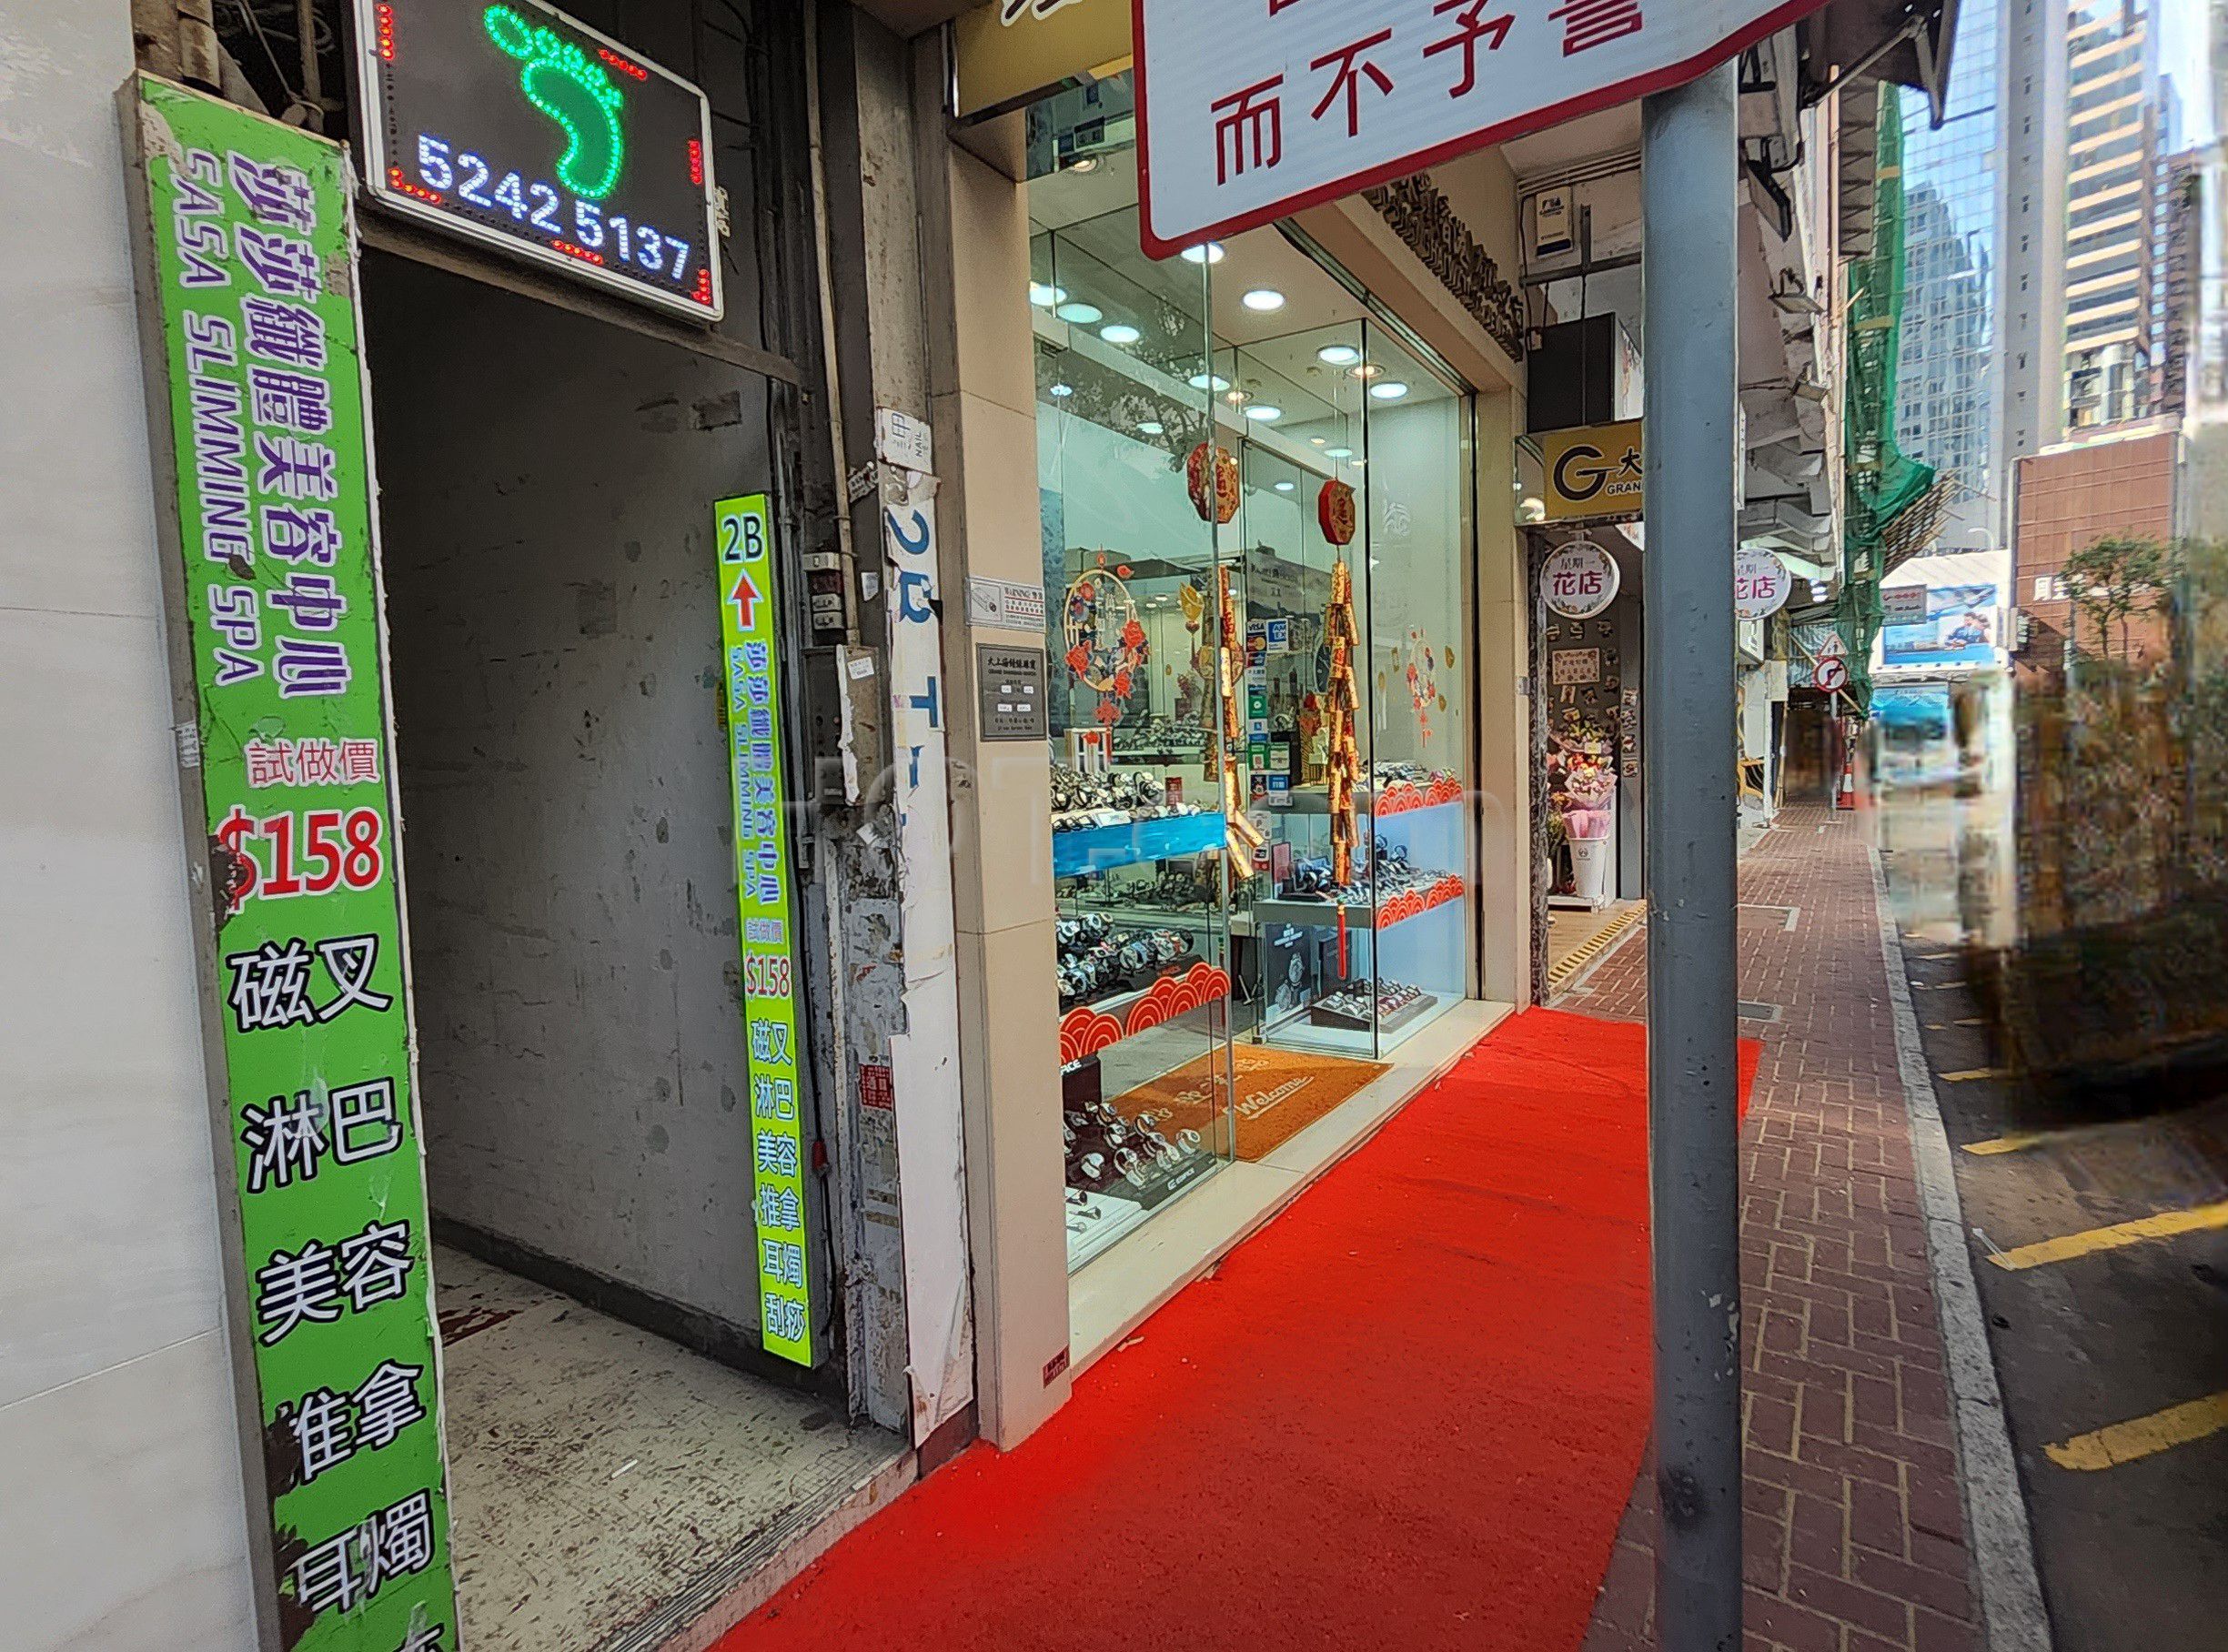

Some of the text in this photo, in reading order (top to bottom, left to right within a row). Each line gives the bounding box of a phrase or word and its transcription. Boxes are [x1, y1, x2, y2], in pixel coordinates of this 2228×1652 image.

[418, 133, 691, 280] 5242 5137
[171, 148, 264, 685] SASA SLIMMING SPA
[228, 151, 351, 698] 莎莎纖體美容中心
[721, 514, 764, 564] 2B
[1553, 570, 1602, 597] 花店
[1248, 623, 1265, 631] VISA
[245, 738, 380, 788] 試做價
[735, 721, 753, 840] SLIMMING
[217, 805, 383, 914] $158
[742, 851, 758, 899] SPA
[226, 932, 394, 1033] 磁叉
[745, 950, 791, 1000] $158
[751, 1017, 792, 1066] 磁叉
[753, 1072, 795, 1122] 淋巴
[240, 1076, 403, 1194] 淋巴
[756, 1128, 798, 1178] 美容
[759, 1183, 801, 1232] 推拿
[256, 1219, 414, 1347] 美容
[761, 1239, 803, 1288] 耳燭
[764, 1293, 806, 1343] 刮痧
